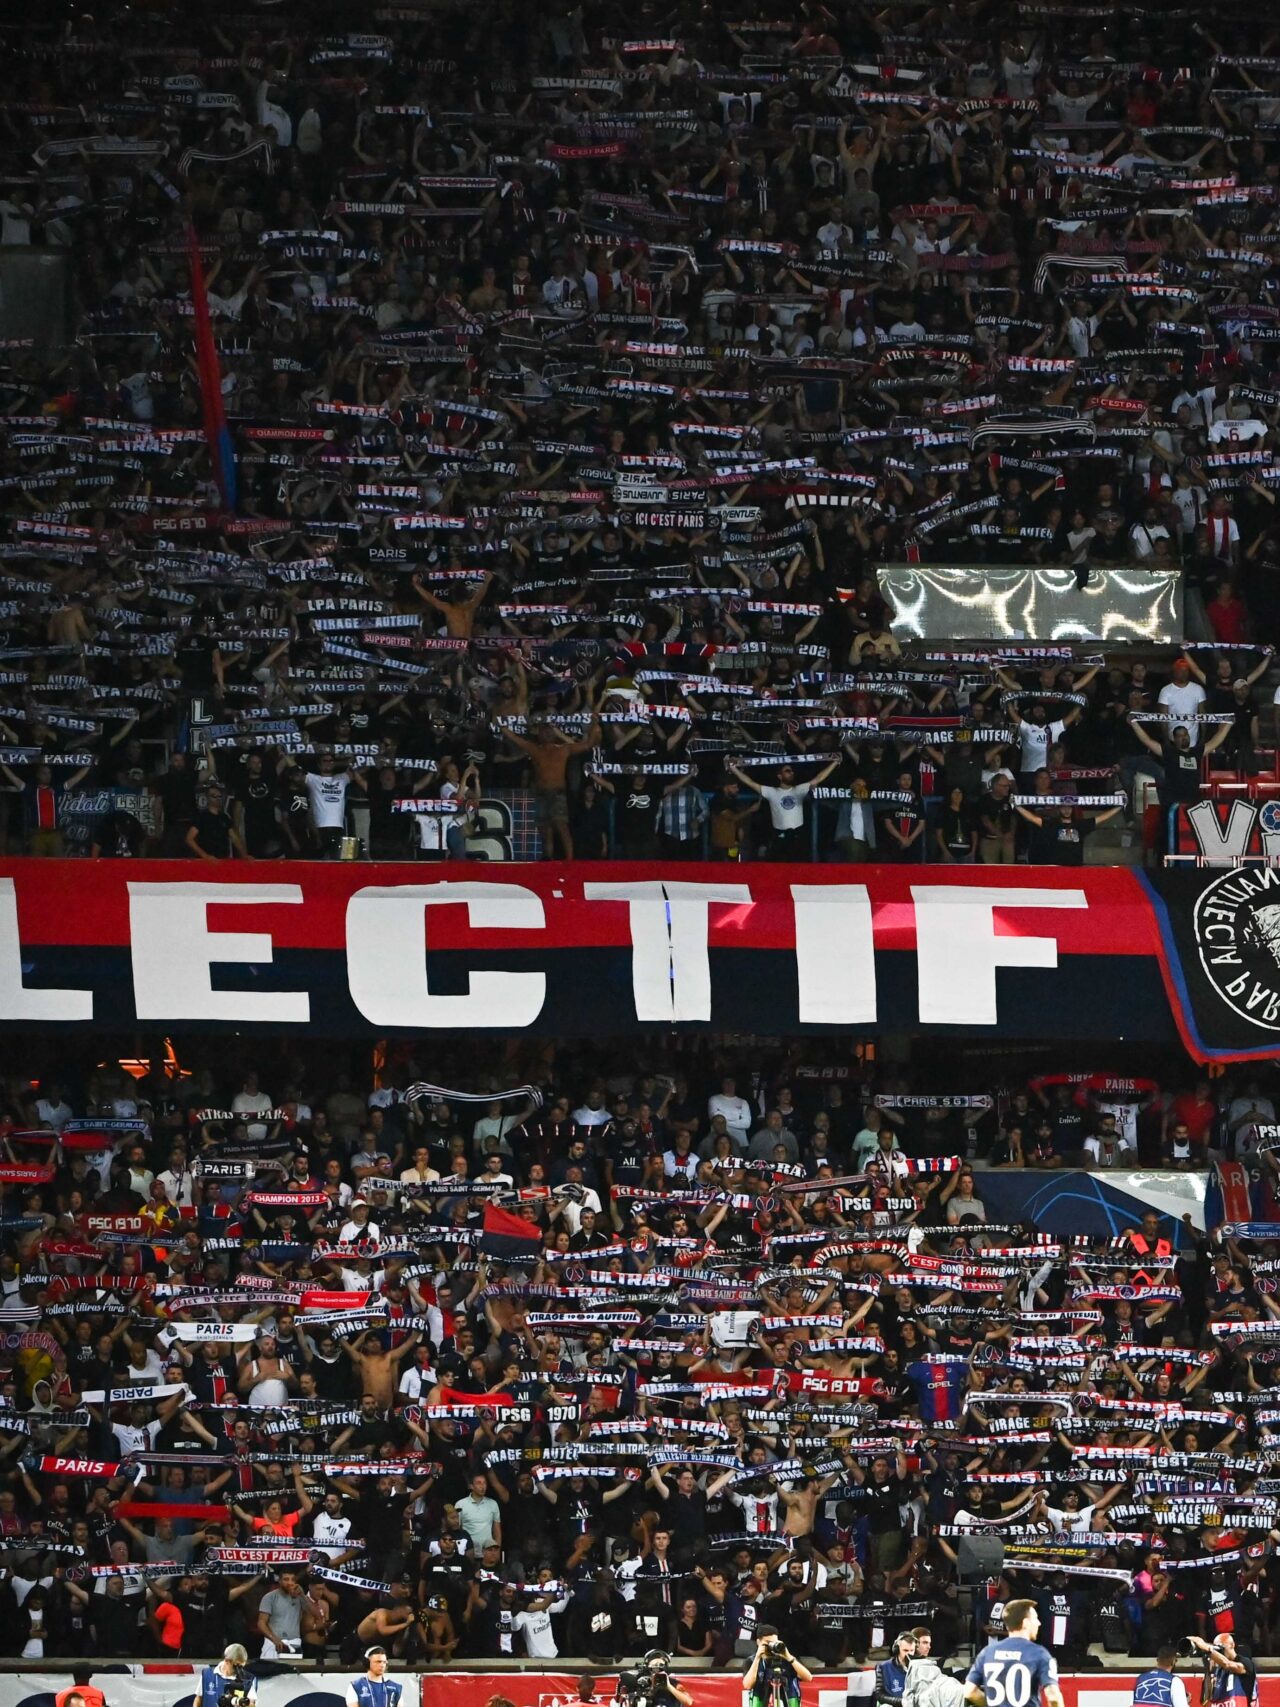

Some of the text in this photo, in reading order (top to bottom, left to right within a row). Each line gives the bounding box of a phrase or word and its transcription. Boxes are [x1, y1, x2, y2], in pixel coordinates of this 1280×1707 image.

[678, 515, 703, 528] PARIS
[370, 548, 406, 558] PARIS
[340, 600, 382, 612] PARIS
[748, 603, 822, 616] ULTRAS
[998, 648, 1072, 657] ULTRAS
[256, 733, 301, 745] PARIS
[334, 744, 379, 755] PARIS
[643, 764, 689, 774] PARIS
[1015, 795, 1124, 806] VIRAGE AUTEUIL
[1106, 1079, 1135, 1090] PARIS
[205, 1165, 241, 1174] PARIS
[254, 1194, 320, 1203] CHAMPION 2013
[844, 1197, 871, 1210] PSG
[88, 1217, 113, 1229] PSG
[591, 1271, 670, 1285] ULTRAS
[529, 1313, 565, 1323] VIRAGE
[598, 1313, 637, 1322] AUTEUIL
[197, 1325, 234, 1334] PARIS
[803, 1378, 859, 1390] PSG 1970
[927, 1381, 953, 1389] OPEL
[501, 1407, 576, 1420] PSG 1970
[747, 1409, 792, 1421] VIRAGE
[812, 1413, 859, 1426] AUTEUIL
[989, 1417, 1029, 1432] VIRAGE
[1073, 1447, 1153, 1460] PARIS
[55, 1459, 104, 1473] PARIS
[1155, 1512, 1201, 1526] VIRAGE
[1224, 1515, 1274, 1528] AUTEUIL
[239, 1550, 269, 1561] C'EST
[272, 1550, 303, 1561] PARIS
[1049, 1604, 1071, 1613] QATAR
[983, 1663, 1032, 1707] 30
